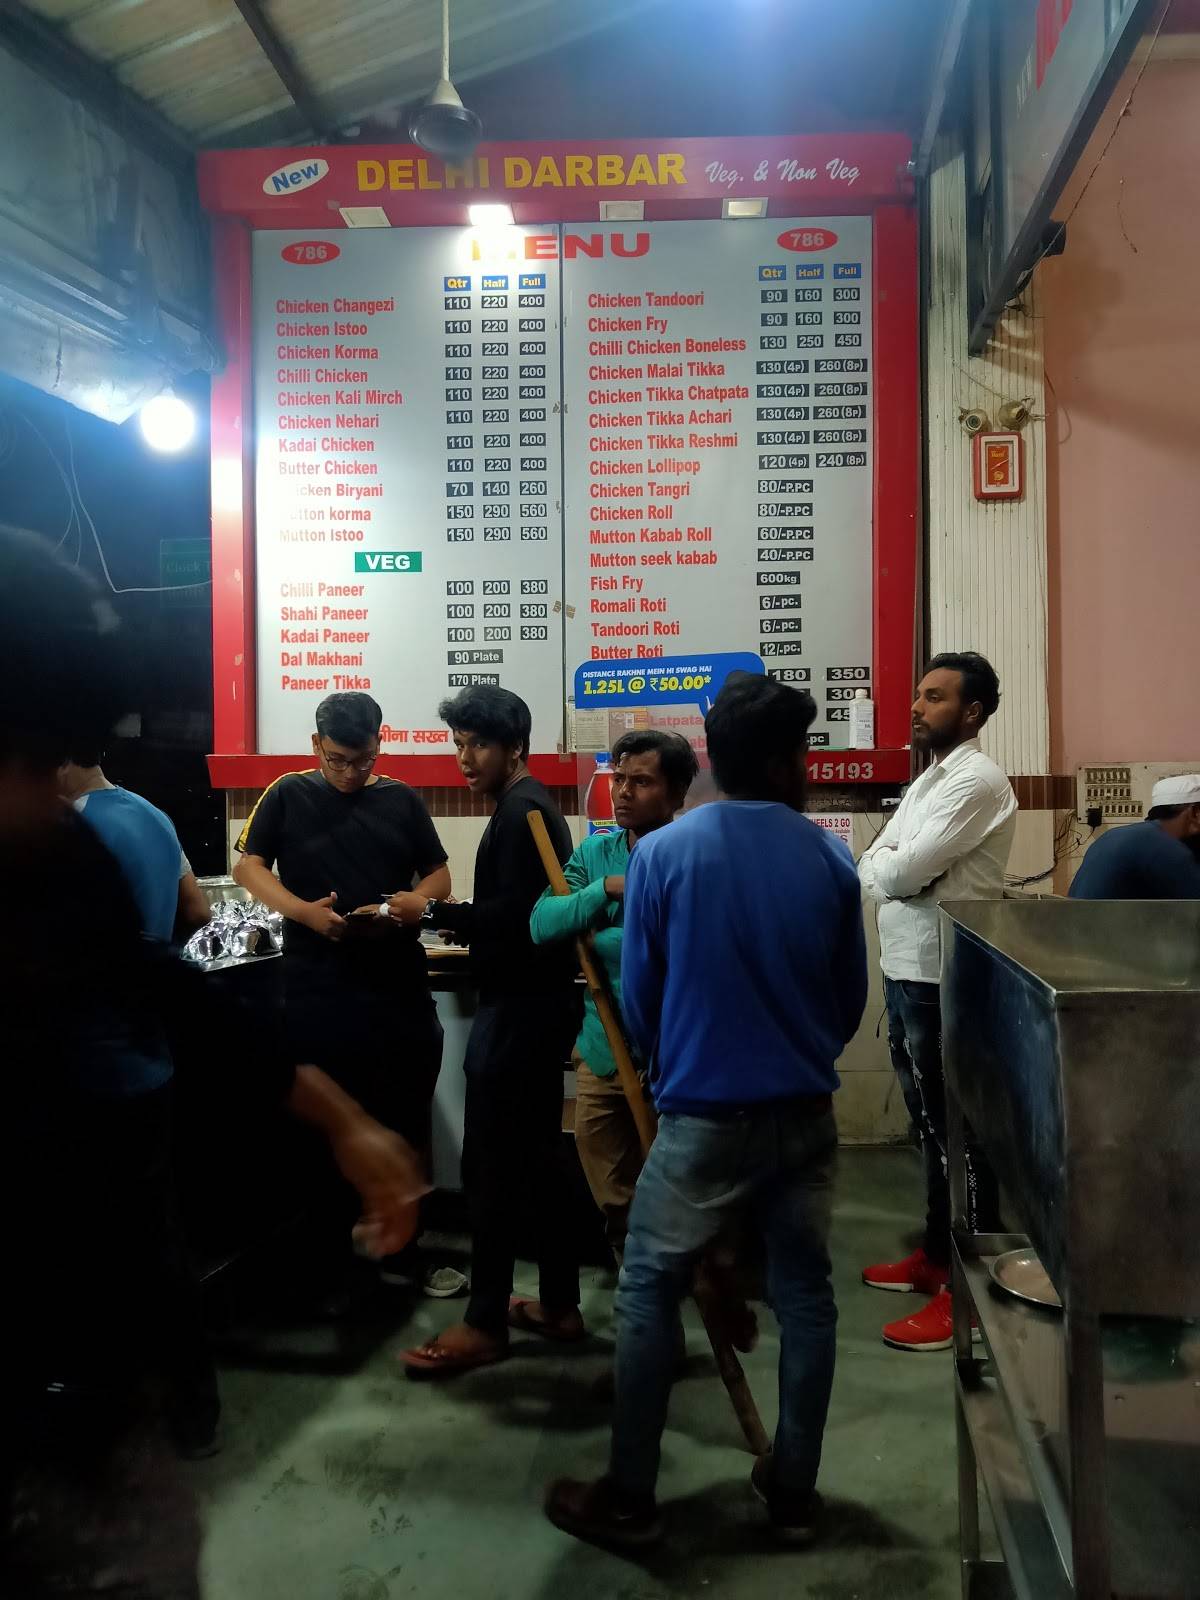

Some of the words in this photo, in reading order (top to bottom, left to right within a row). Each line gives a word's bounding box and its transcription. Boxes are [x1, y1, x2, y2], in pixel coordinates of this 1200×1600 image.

[271, 163, 319, 192] New
[357, 157, 489, 192] DELHI
[504, 154, 688, 188] DARBAR
[705, 161, 744, 189] Veg.
[754, 160, 769, 182] &
[777, 159, 818, 182] Non
[826, 158, 861, 186] Veg
[790, 233, 824, 247] 786
[294, 246, 328, 260] 786
[762, 268, 783, 279] Qtr
[798, 268, 821, 277] Half
[838, 266, 857, 276] Full
[447, 279, 468, 288] Qtr
[484, 279, 506, 288] Half
[523, 278, 540, 286] Full
[276, 299, 329, 314] Chicken
[333, 297, 394, 315] Changezi
[447, 298, 469, 308] 110
[484, 296, 505, 307] 220
[520, 296, 542, 306] 400
[588, 293, 642, 308] Chicken
[646, 291, 704, 306] Tandoori
[766, 291, 782, 302] 90
[797, 290, 820, 300] 160
[836, 289, 858, 300] 300
[276, 322, 329, 337] Chicken
[334, 321, 367, 336] Istoo
[448, 322, 469, 332] 110
[484, 321, 506, 331] 220
[521, 320, 543, 330] 400
[588, 317, 642, 333] Chicken
[646, 315, 667, 335] Fry
[766, 314, 782, 325] 90
[798, 313, 820, 324] 160
[836, 313, 858, 323] 300
[277, 345, 329, 360] Chicken
[334, 344, 379, 360] Korma
[448, 346, 469, 356] 110
[484, 344, 506, 355] 220
[522, 344, 543, 353] 400
[588, 341, 622, 356] Chilli
[628, 339, 681, 354] Chicken
[685, 337, 746, 353] Boneless
[762, 337, 784, 348] 130
[799, 336, 821, 347] 250
[837, 335, 859, 346] 450
[277, 369, 311, 384] Chilli
[316, 368, 368, 383] Chicken
[588, 365, 643, 381] Chicken
[646, 363, 683, 378] Malai
[688, 362, 725, 376] Tikka
[278, 392, 331, 406] Chicken
[335, 390, 361, 405] Kali
[365, 389, 403, 404] Mirch
[448, 389, 470, 400] 110
[485, 388, 506, 399] 220
[521, 387, 543, 397] 400
[588, 390, 642, 406] Chicken
[647, 387, 684, 401] Tikka
[688, 384, 749, 403] Chatpata
[279, 415, 332, 429] Chicken
[335, 414, 380, 429] Nehari
[449, 412, 470, 422] 110
[485, 411, 507, 421] 220
[522, 410, 544, 420] 400
[588, 413, 643, 430] Chicken
[646, 410, 685, 426] Tikka
[688, 409, 733, 424] Achari
[279, 438, 316, 453] Kadai
[322, 437, 375, 452] Chicken
[588, 437, 643, 452] Chicken
[648, 434, 685, 449] Tikka
[688, 433, 739, 449] Reshmi
[324, 460, 378, 475] Chicken
[589, 461, 643, 477] Chicken
[648, 459, 701, 475] Lollipop
[336, 483, 383, 500] Biryani
[452, 484, 468, 495] 70
[485, 483, 508, 495] 140
[522, 482, 545, 494] 260
[589, 482, 643, 499] Chicken
[648, 481, 691, 500] Tangri
[330, 506, 371, 521] korma
[448, 506, 472, 518] 150
[485, 505, 508, 517] 290
[522, 504, 545, 517] 560
[589, 506, 643, 521] Chicken
[648, 504, 673, 520] Roll
[330, 528, 364, 541] Istoo
[448, 528, 472, 541] 150
[486, 528, 509, 540] 290
[522, 527, 546, 539] 560
[589, 530, 636, 545] Mutton
[640, 528, 683, 543] Kabab
[687, 527, 712, 542] Roll
[366, 555, 411, 570] VEG
[590, 553, 636, 568] Mutton
[640, 552, 672, 566] seek
[676, 551, 718, 565] kabab
[318, 582, 365, 597] Paneer
[448, 582, 472, 594] 100
[485, 582, 508, 594] 200
[523, 581, 546, 593] 380
[590, 576, 618, 591] Fish
[622, 575, 643, 593] Fry
[280, 606, 318, 621] Shahi
[322, 606, 368, 621] Paneer
[449, 606, 472, 617] 100
[486, 605, 509, 617] 200
[522, 605, 545, 617] 380
[590, 598, 636, 613] Romali
[640, 598, 667, 612] Roti
[280, 628, 319, 644] Kadai
[323, 628, 370, 643] Paneer
[449, 629, 473, 641] 100
[486, 628, 509, 640] 200
[522, 627, 545, 639] 380
[591, 621, 649, 638] Tandoori
[653, 619, 681, 635] Roti
[281, 652, 302, 667] Dal
[307, 652, 363, 666] Makhani
[455, 652, 469, 664] 90
[473, 651, 499, 662] Plate
[591, 645, 632, 660] Butter
[637, 645, 663, 659] Roti
[583, 670, 615, 678] DISTANCE
[617, 669, 645, 677] RAKHNE
[772, 670, 807, 681] 180
[832, 668, 865, 679] 350
[282, 675, 329, 691] Paneer
[333, 675, 371, 690] Tikka
[451, 675, 469, 686] 170
[471, 675, 497, 685] Plate
[584, 680, 624, 695] 1.25L
[628, 676, 646, 693] @
[809, 762, 874, 780] 15193
[841, 818, 850, 827] GO
